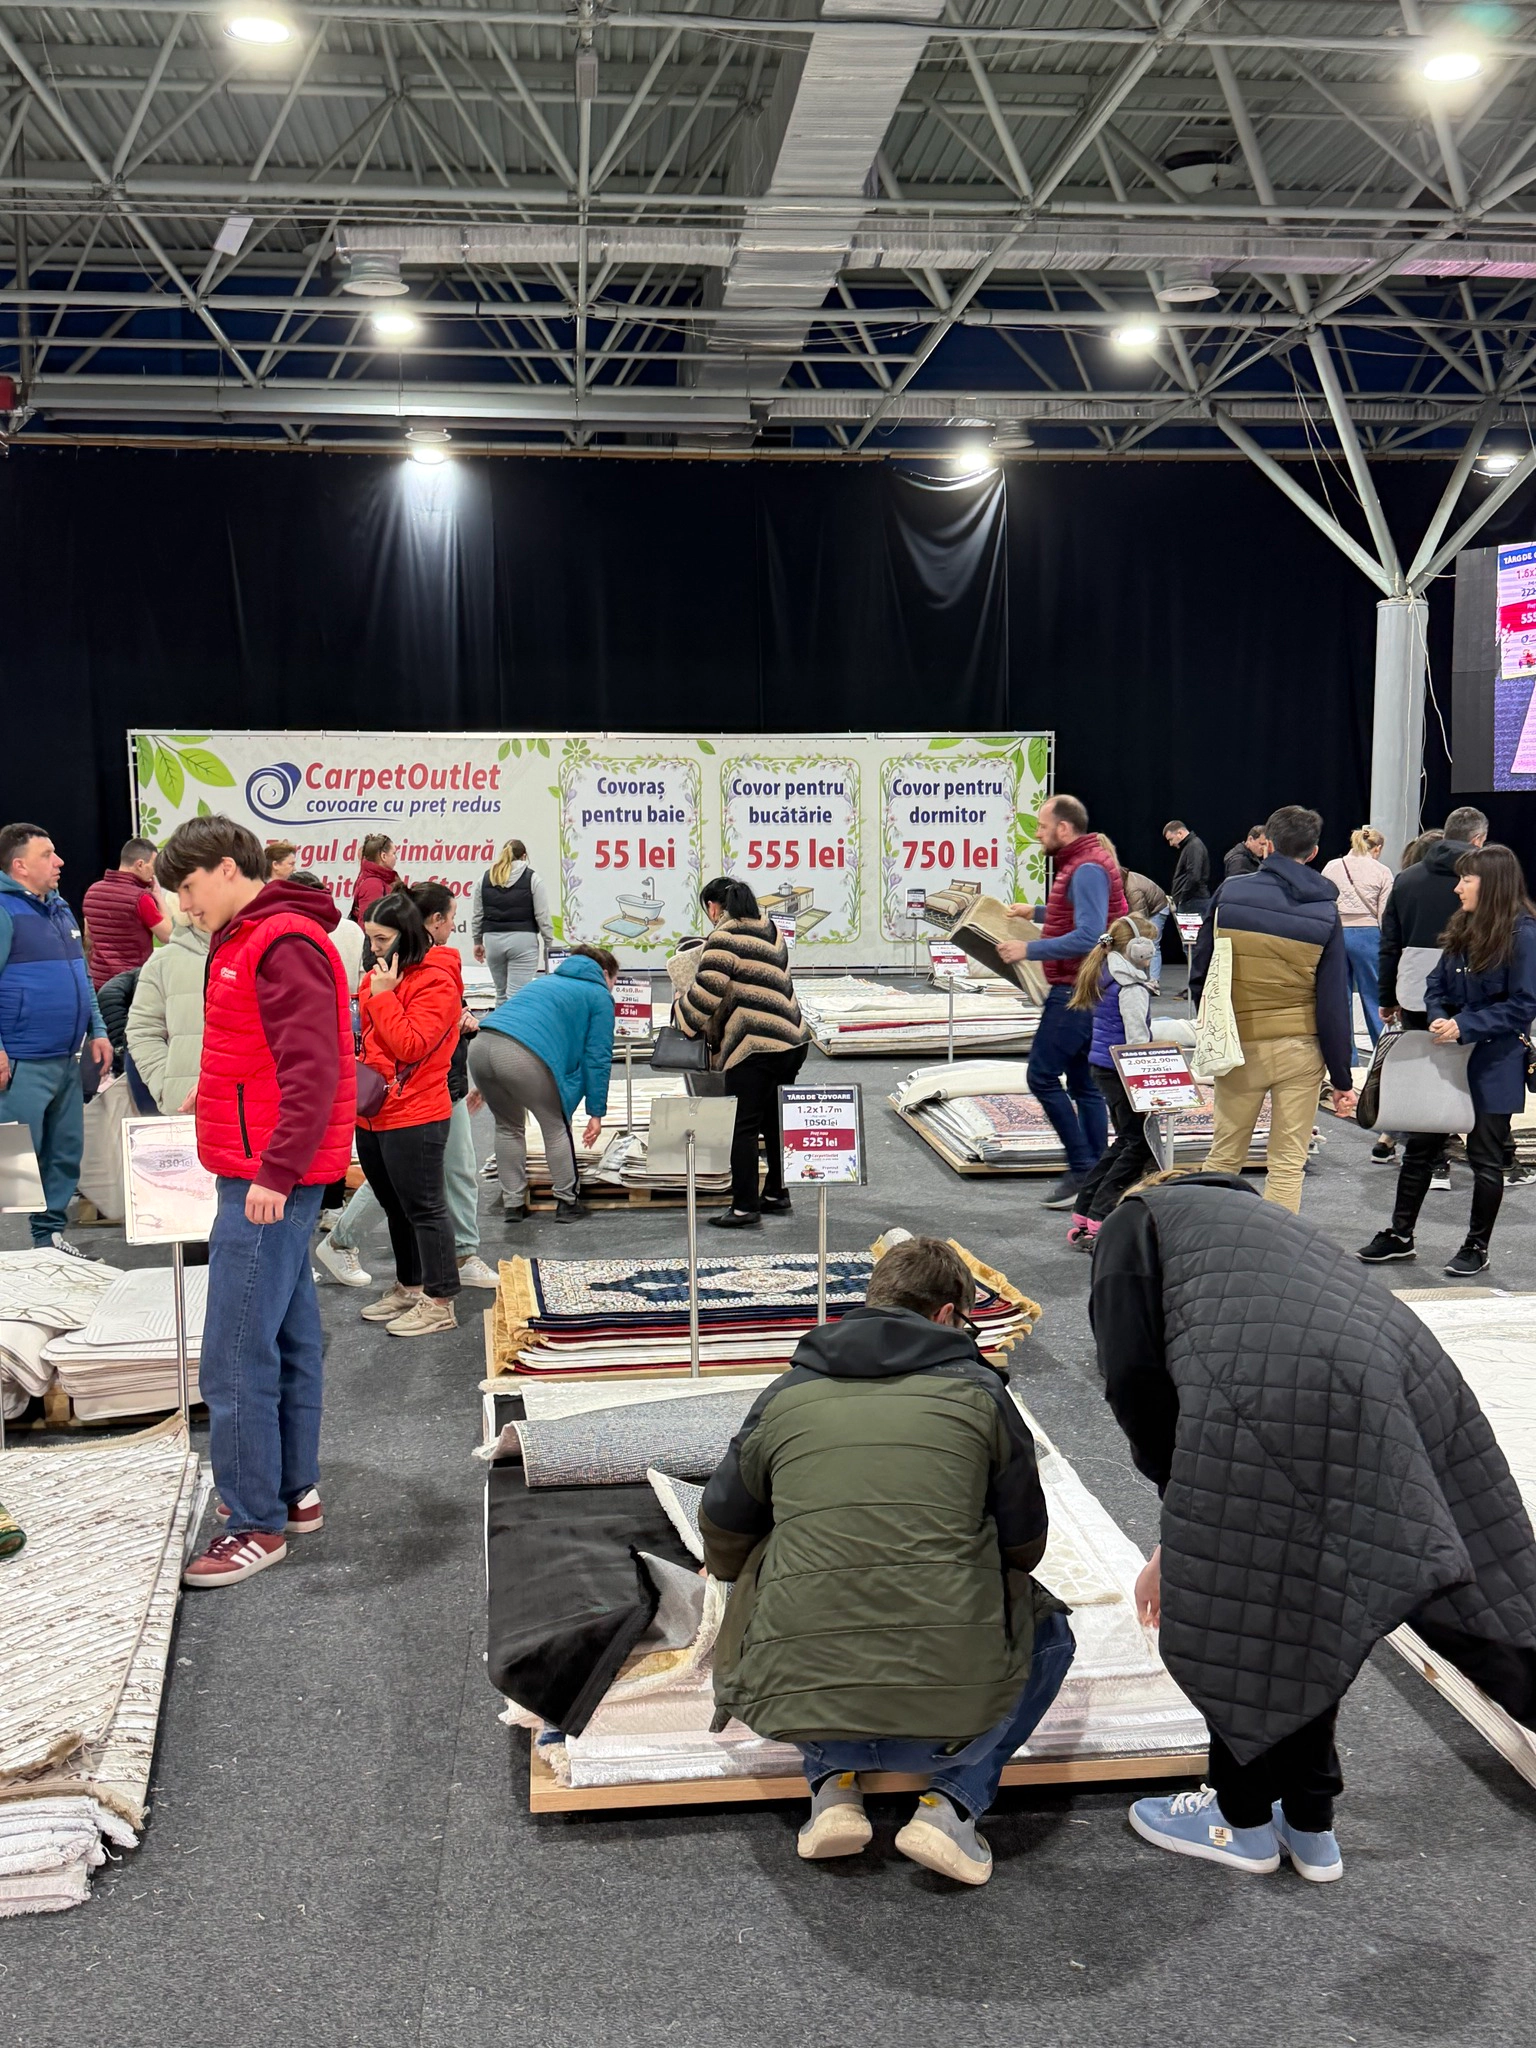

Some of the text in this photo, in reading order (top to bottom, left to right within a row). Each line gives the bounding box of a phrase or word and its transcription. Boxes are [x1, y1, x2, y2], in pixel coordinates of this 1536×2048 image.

[305, 762, 501, 796] CarpetOutlet
[597, 777, 665, 800] Covoraș
[732, 778, 844, 800] Covor pentru
[892, 778, 1003, 800] Covor pentru
[306, 795, 501, 818] covoare cu preț redus
[581, 804, 685, 827] pentru baie
[748, 805, 833, 824] bucătărie
[909, 805, 987, 824] dormitor
[394, 838, 495, 862] rimăvară
[594, 837, 676, 869] 55 lei
[746, 837, 846, 869] 555 lei
[902, 837, 999, 869] 750 lei
[1142, 1079, 1168, 1087] 3865
[797, 1106, 842, 1114] 1.2x1.7m
[802, 1137, 838, 1147] 525 lei
